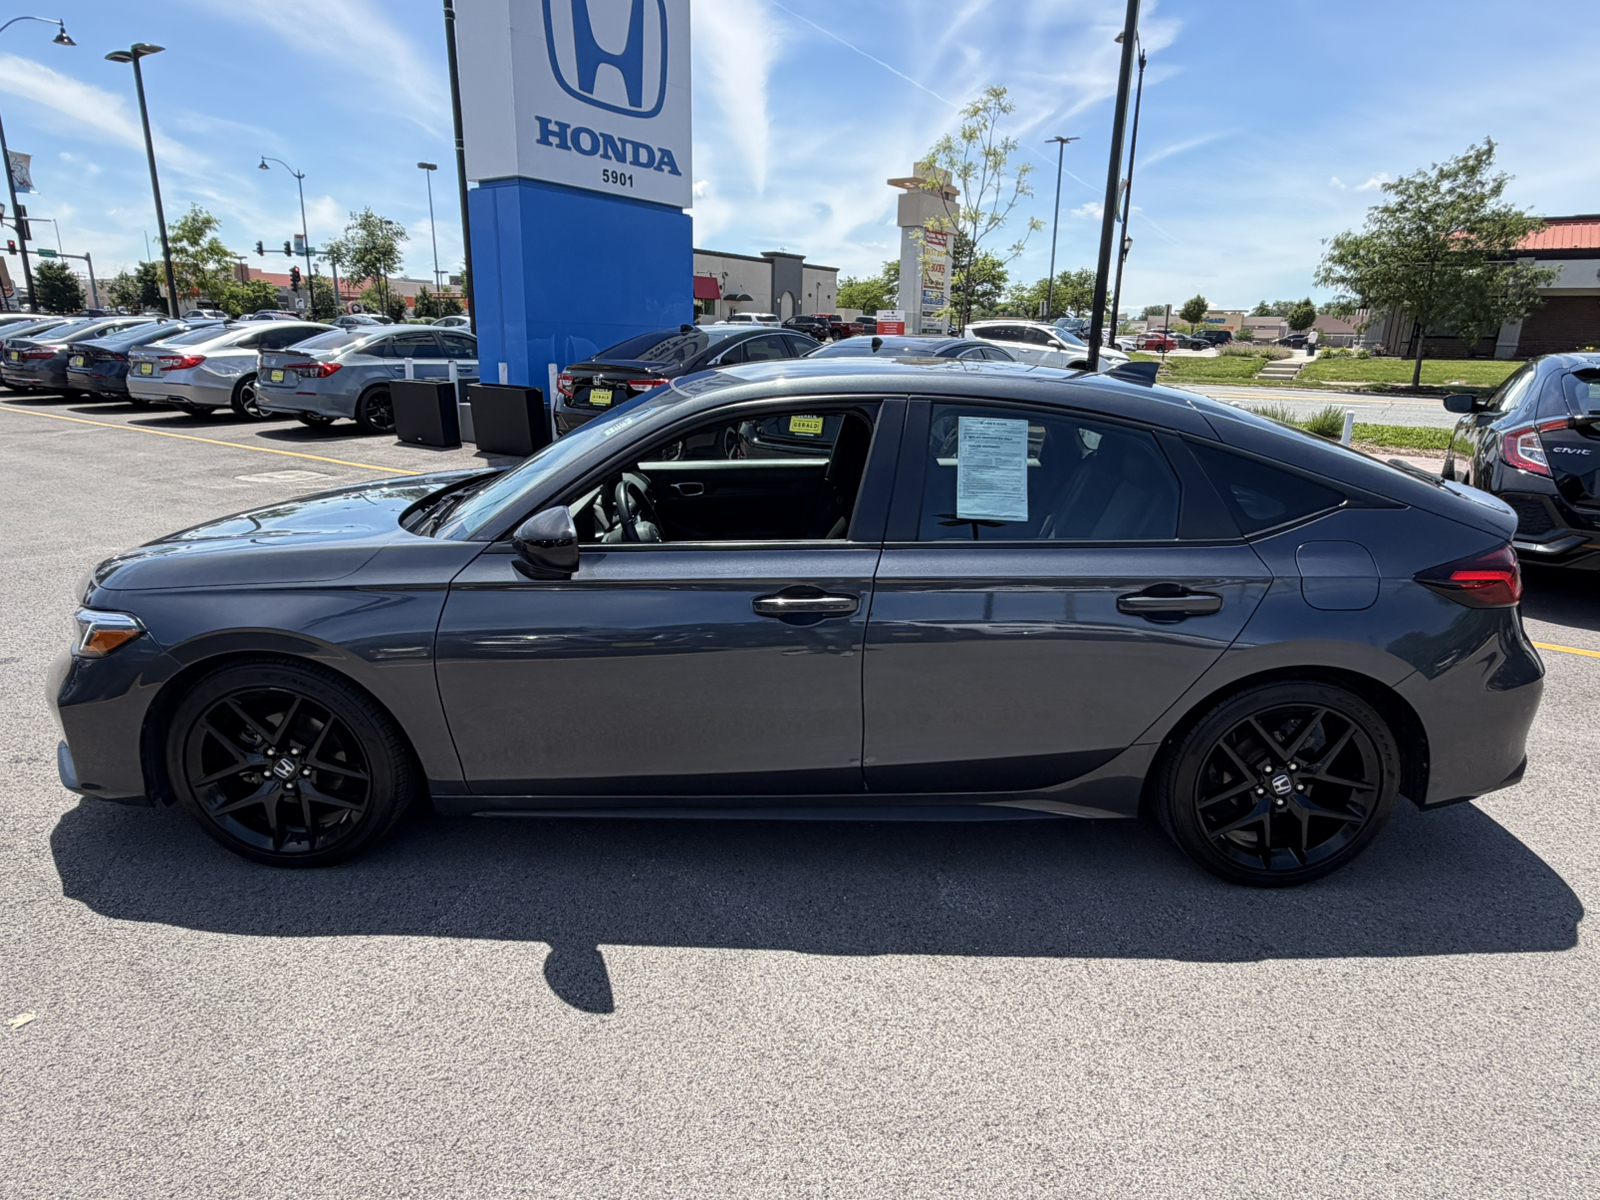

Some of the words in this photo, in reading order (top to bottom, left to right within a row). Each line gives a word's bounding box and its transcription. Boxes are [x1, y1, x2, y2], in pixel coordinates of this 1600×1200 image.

[535, 115, 682, 176] HONDA
[602, 169, 634, 188] 5901
[793, 421, 819, 429] GERALD
[1553, 446, 1591, 456] CIVIC
[1336, 697, 1393, 761] GOODYEAR
